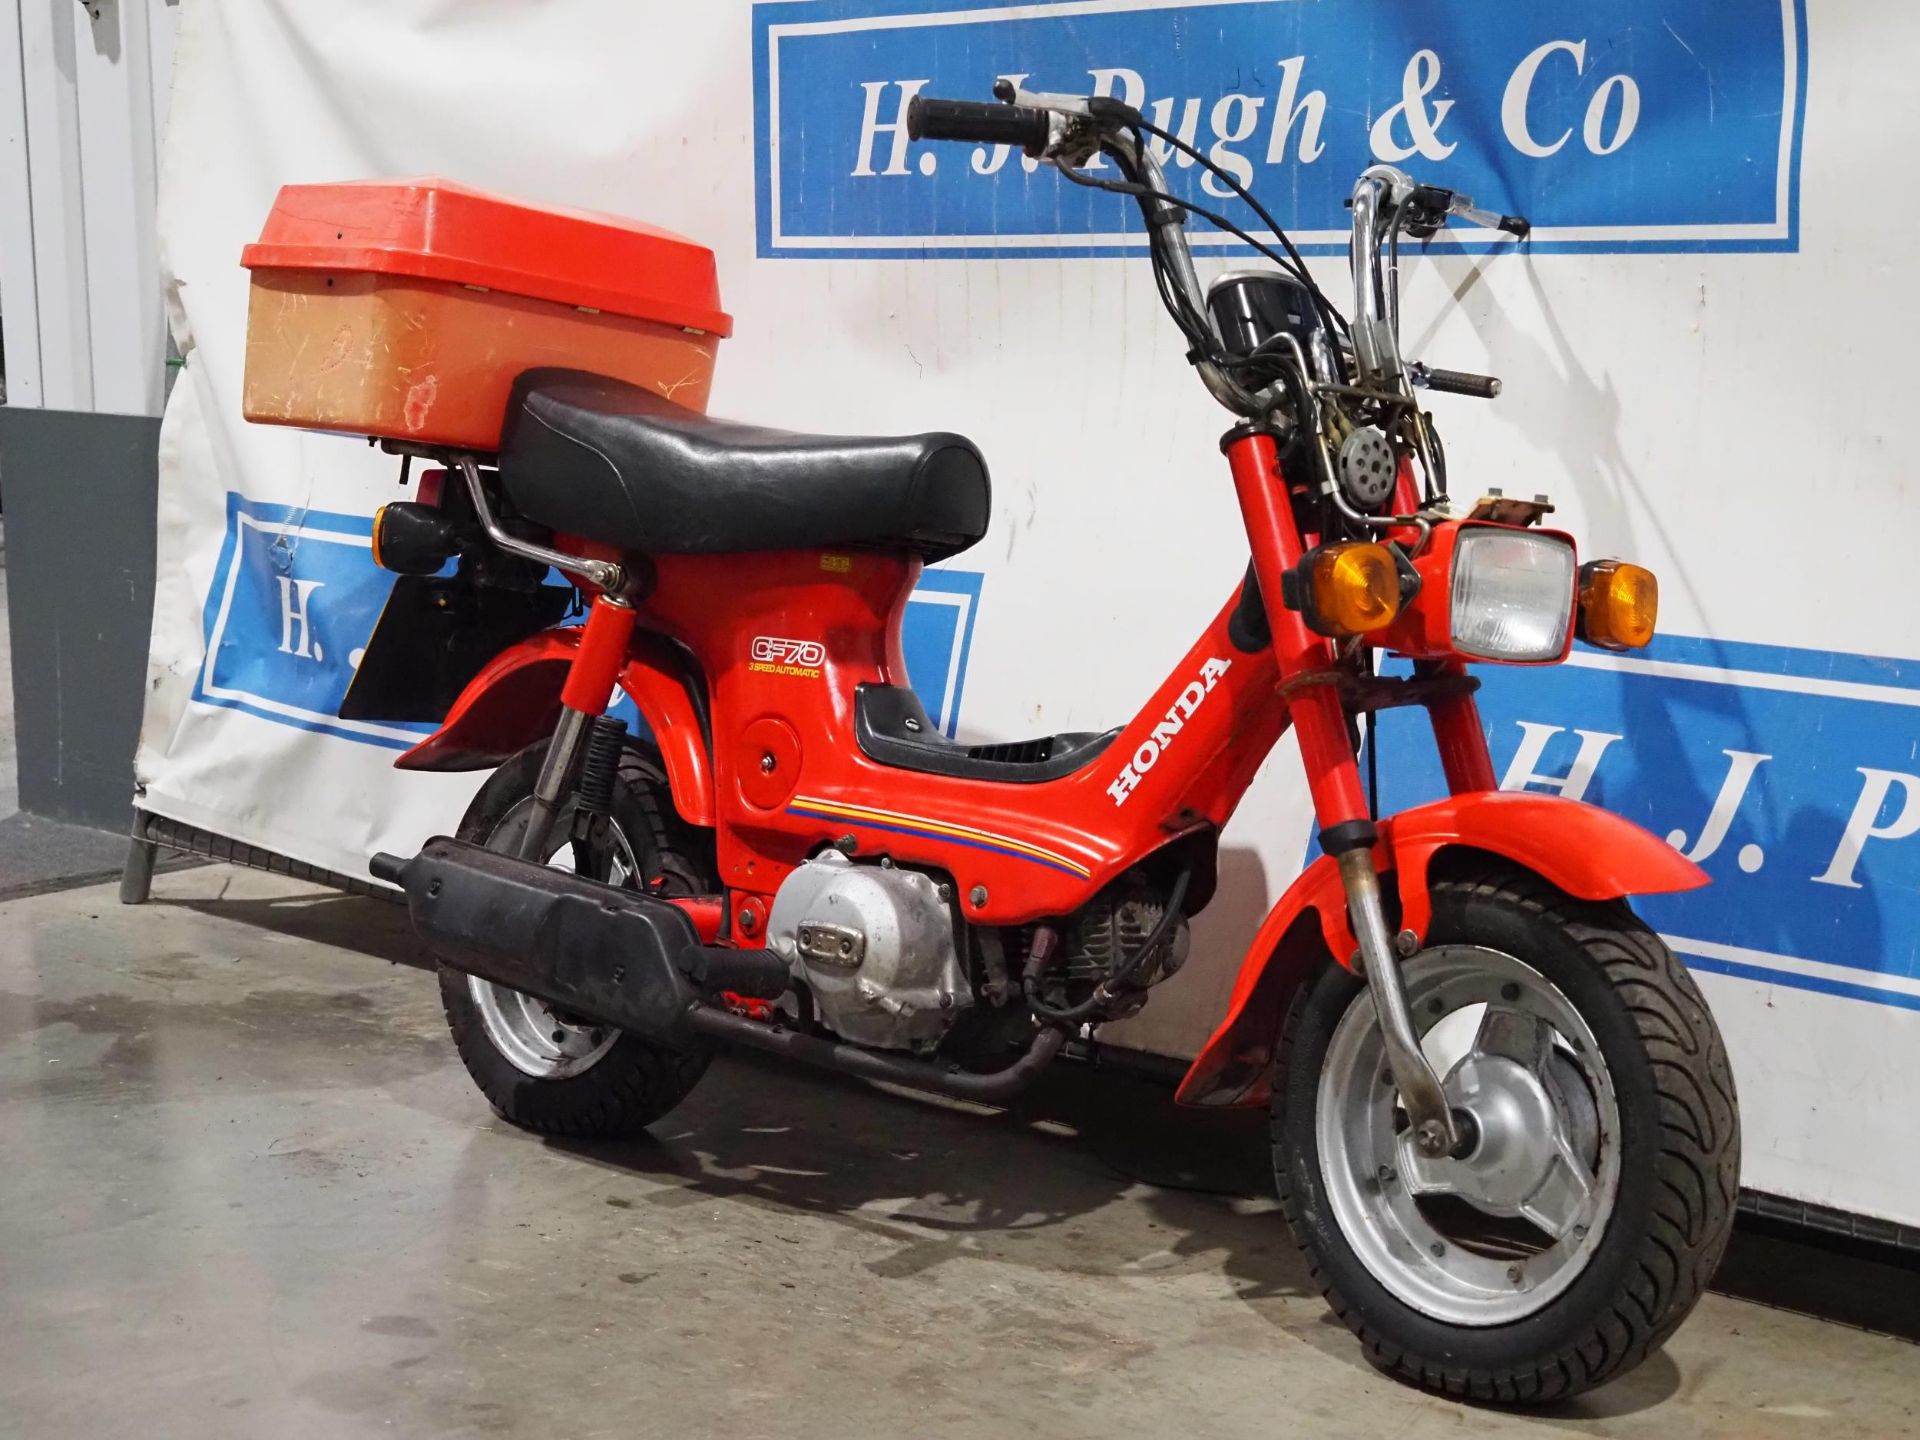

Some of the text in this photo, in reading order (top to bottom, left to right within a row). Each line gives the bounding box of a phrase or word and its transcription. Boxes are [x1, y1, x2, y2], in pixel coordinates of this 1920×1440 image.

[850, 79, 937, 176] H.
[1368, 49, 1457, 163] &
[1500, 39, 1641, 158] Co
[276, 576, 325, 663] H.
[748, 662, 820, 678] 3 SPEED AUTOMATIC
[752, 636, 826, 666] CF70
[1106, 657, 1232, 807] HONDA
[1665, 749, 1772, 873] J.
